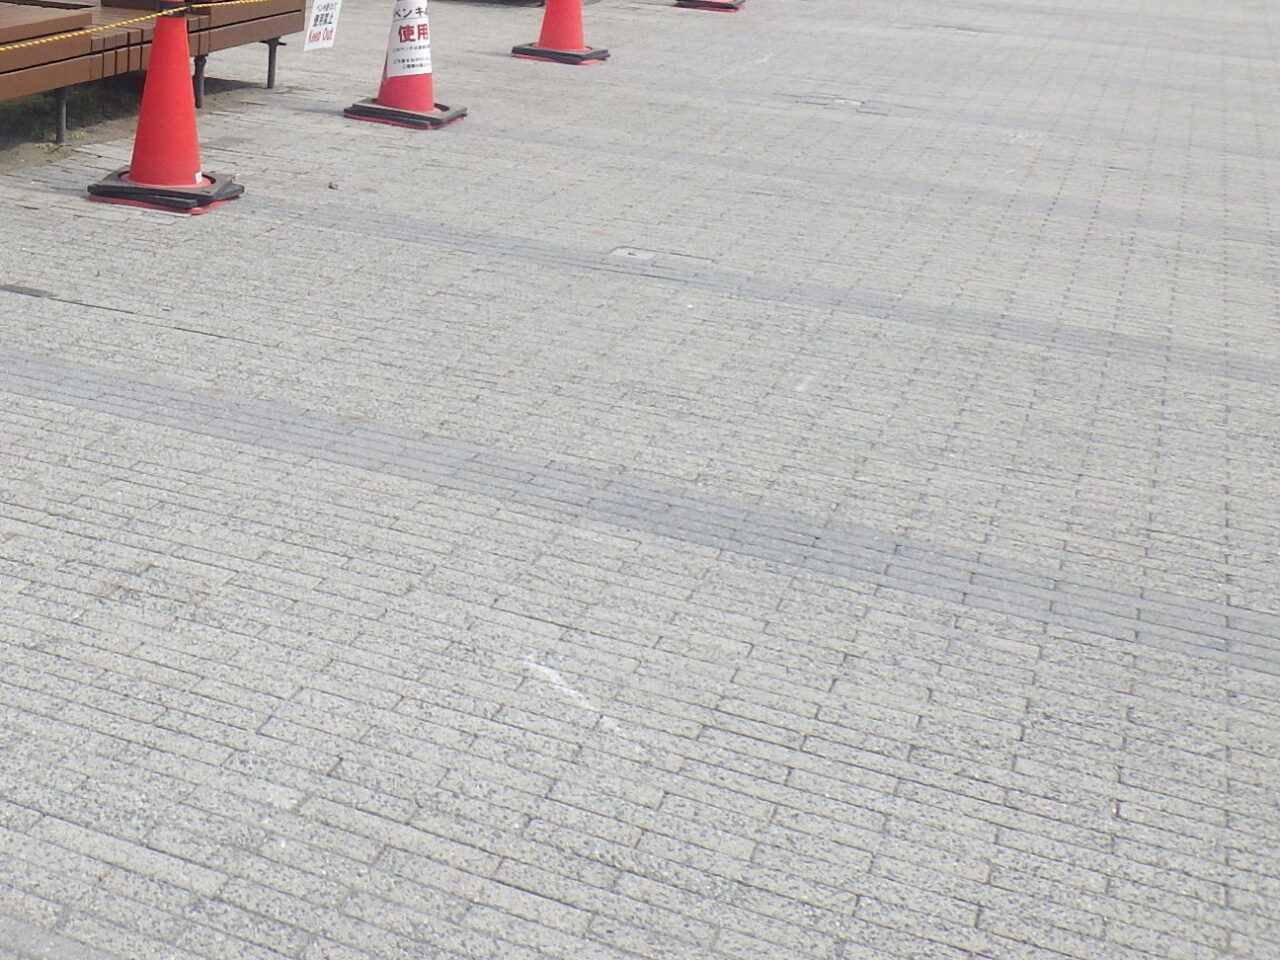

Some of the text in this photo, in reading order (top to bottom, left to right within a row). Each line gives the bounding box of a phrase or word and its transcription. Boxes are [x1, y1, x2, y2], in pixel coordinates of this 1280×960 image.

[394, 6, 428, 19] ペンキ
[398, 23, 429, 44] 使用
